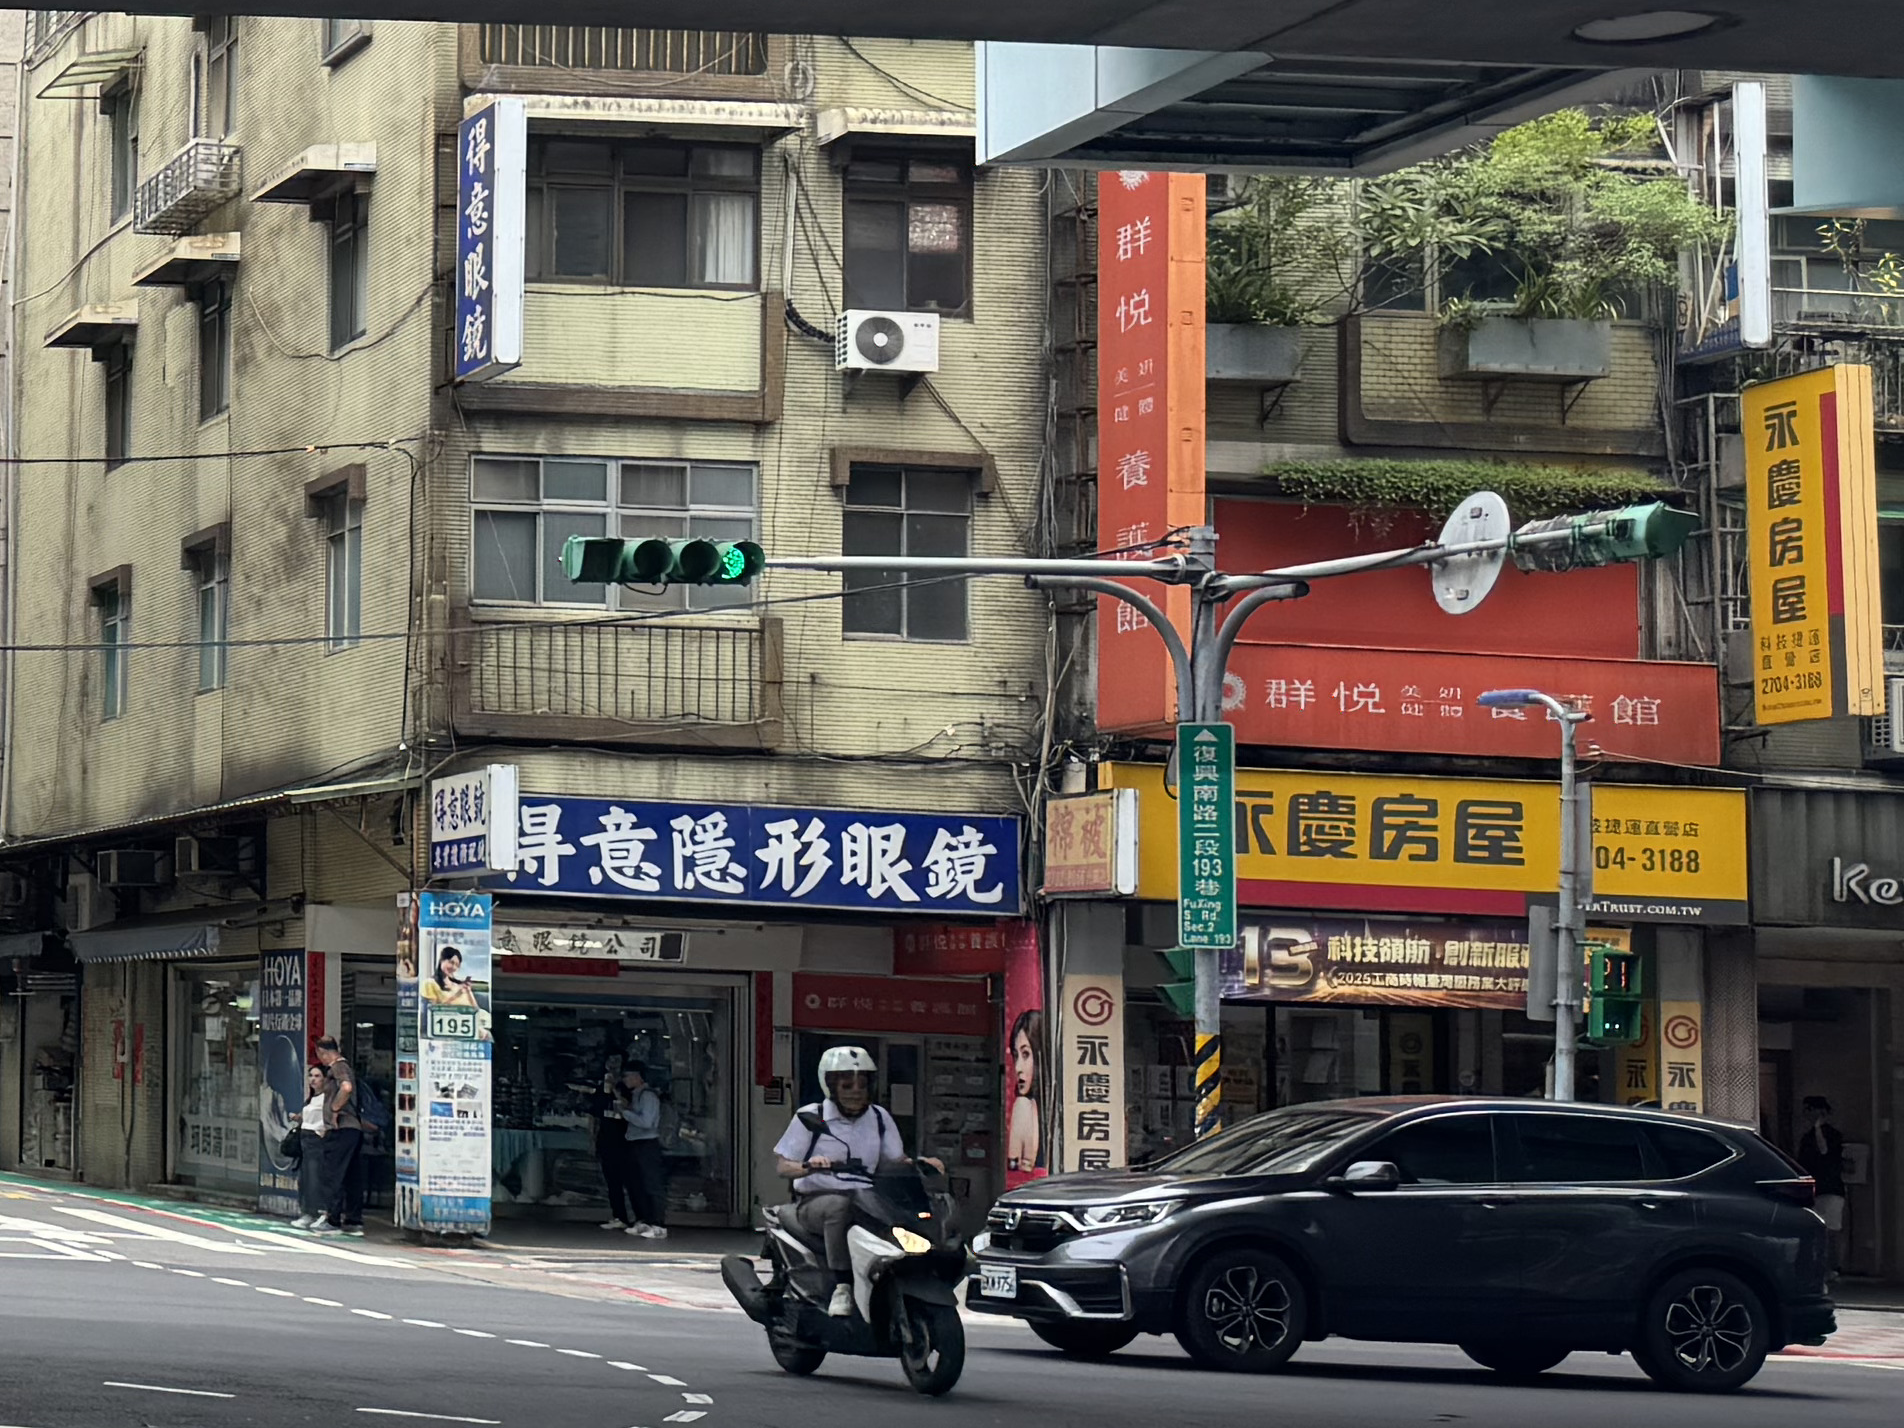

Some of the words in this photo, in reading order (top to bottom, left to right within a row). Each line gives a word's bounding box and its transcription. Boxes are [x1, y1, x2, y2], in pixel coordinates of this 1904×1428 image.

[461, 118, 491, 362] 得意眼鏡
[1763, 400, 1808, 626] 永慶房屋
[507, 803, 1004, 905] 得意隱形眼鏡
[1192, 744, 1223, 897] 復興南路二段193巷
[1235, 789, 1526, 867] 永慶房屋
[429, 901, 486, 918] HOYA
[263, 955, 302, 986] HOYA
[435, 1017, 472, 1035] 195
[1076, 1034, 1111, 1172] 永慶房屋
